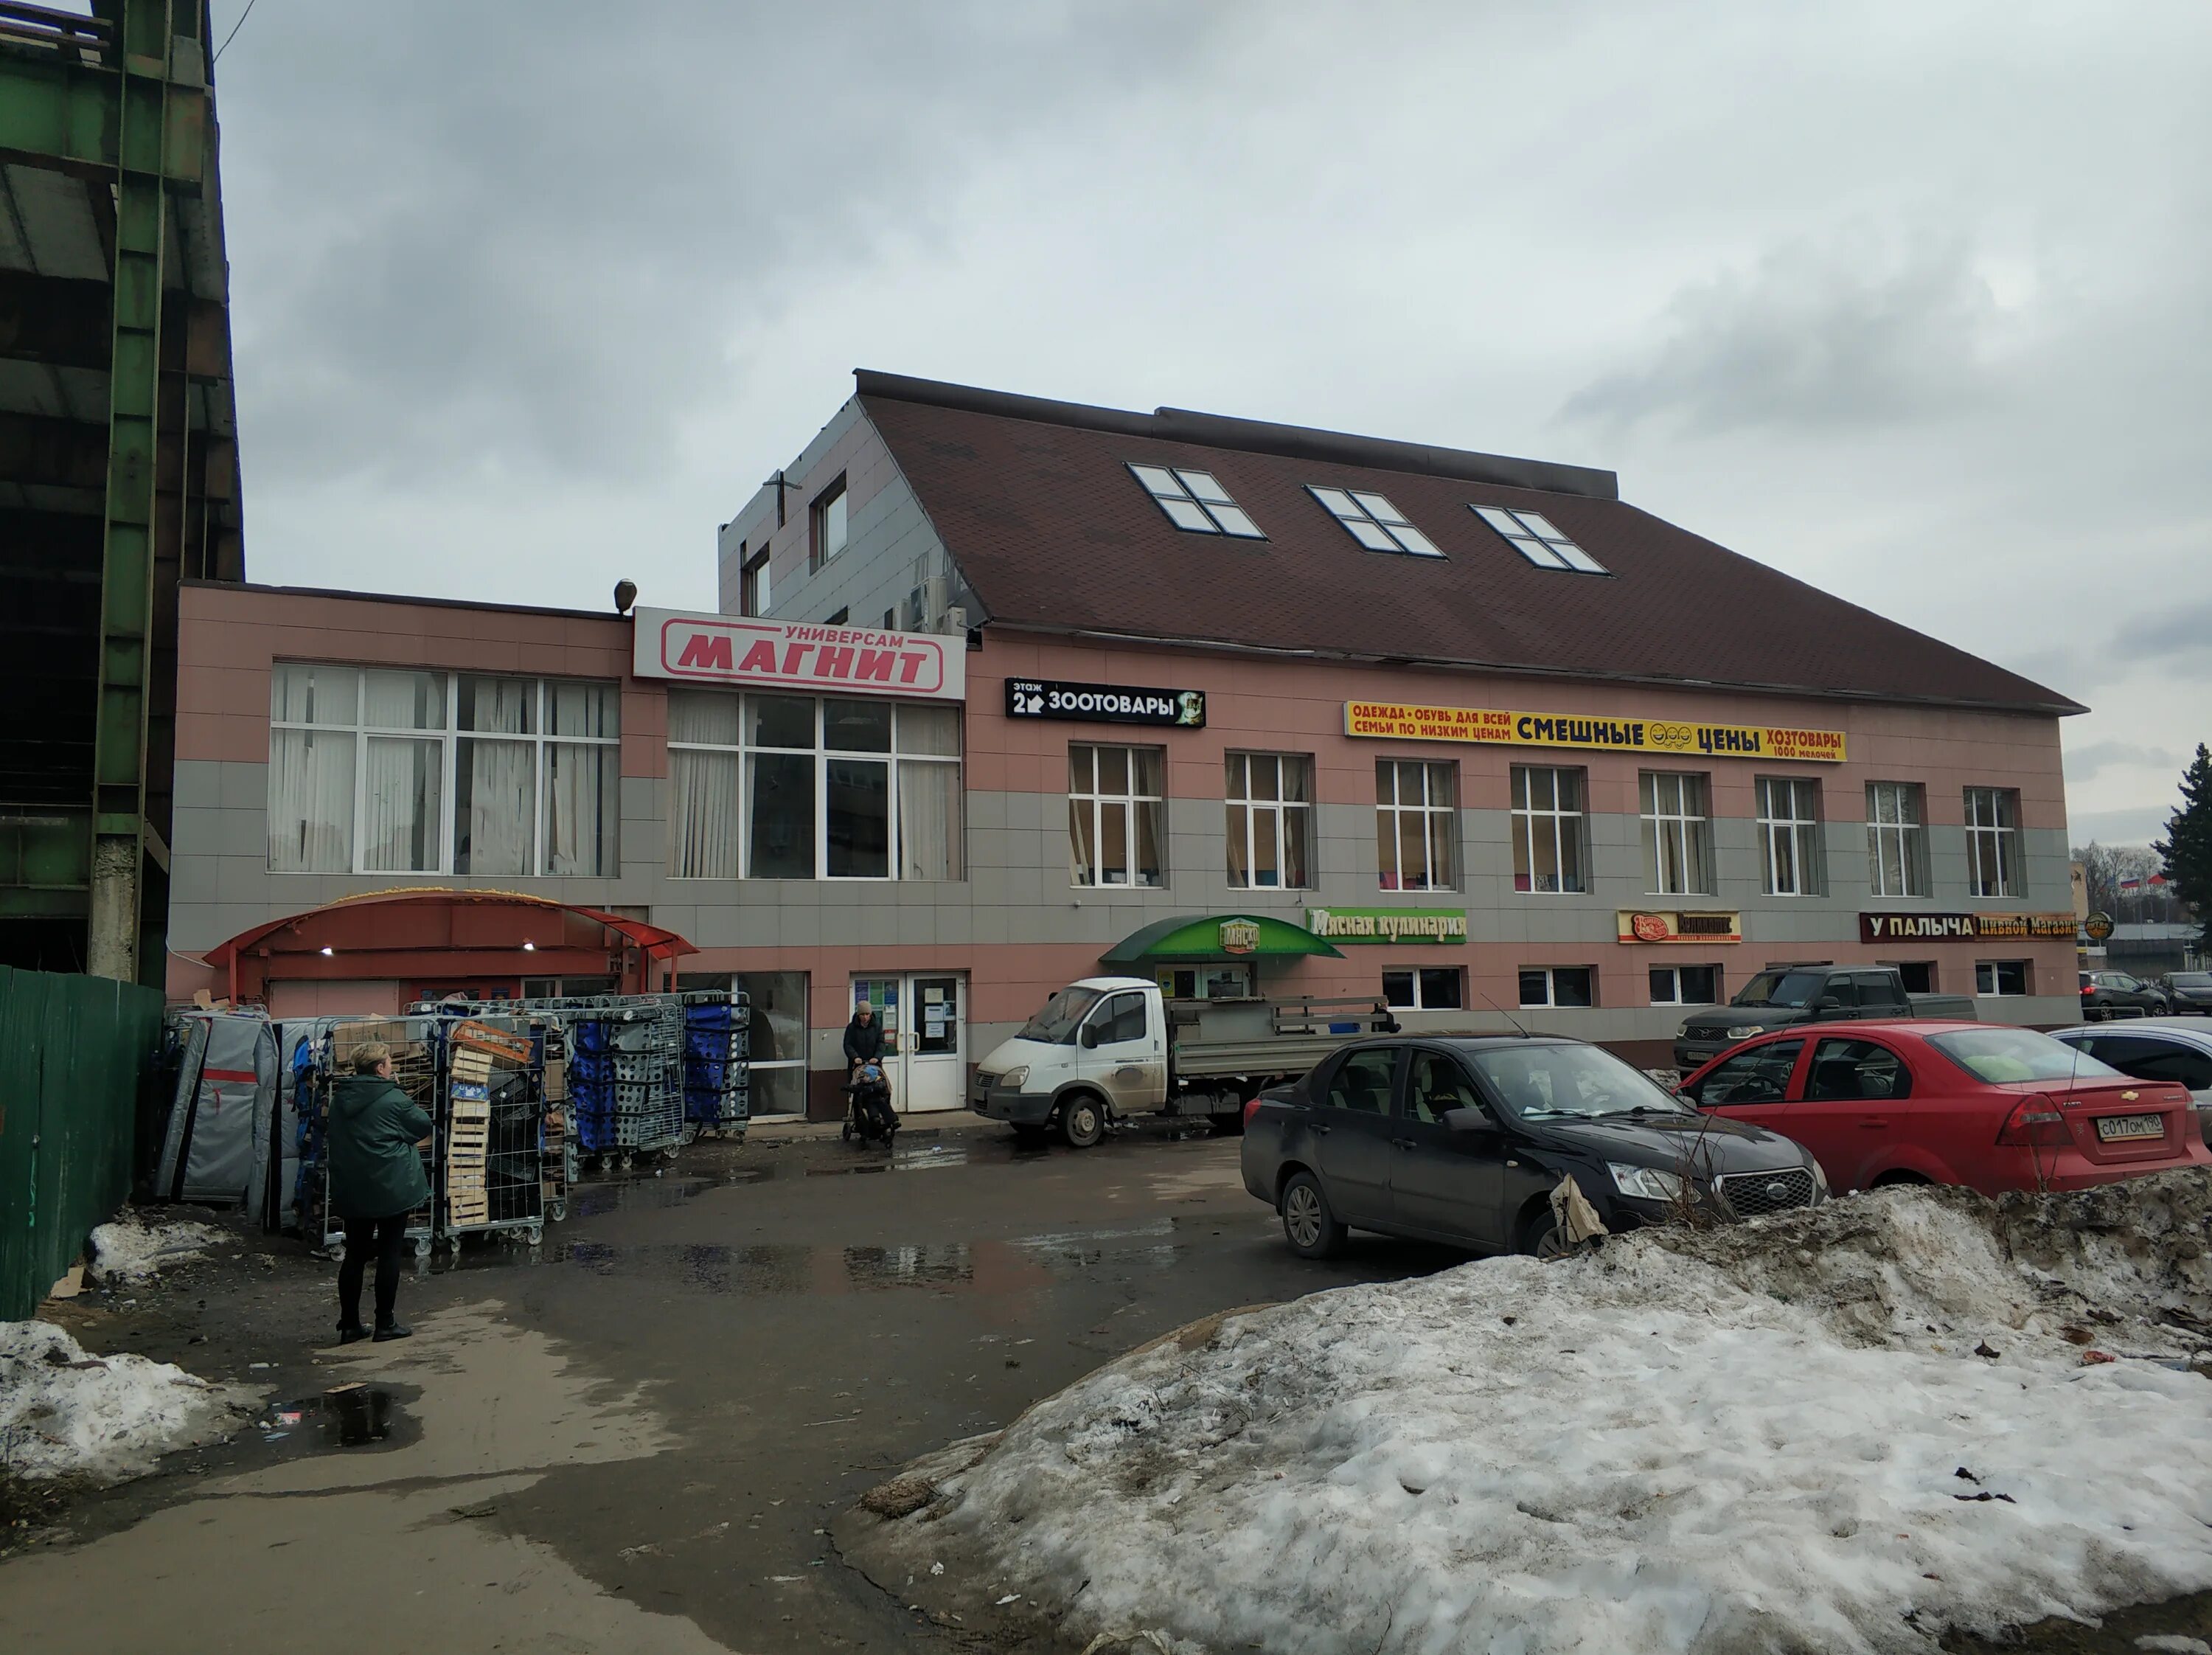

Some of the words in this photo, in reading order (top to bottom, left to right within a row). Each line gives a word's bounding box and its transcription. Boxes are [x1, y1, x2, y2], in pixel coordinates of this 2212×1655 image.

[785, 625, 905, 648] УНИВЕРСАМ
[678, 634, 927, 683] МАГНИТ
[1013, 683, 1042, 692] этаж
[1013, 693, 1026, 713] 2
[1048, 691, 1174, 715] ЗООТОВАРЫ
[1353, 705, 1405, 720] ОДЕЖДА
[1415, 709, 1452, 722] ОБУВЬ
[1456, 712, 1478, 724] ДЛЯ
[1484, 711, 1511, 726] ВСЕЙ
[1354, 721, 1394, 734] СЕМЬИ
[1399, 722, 1416, 735] ПО
[1421, 724, 1468, 738] НИЗКИМ
[1472, 726, 1511, 740] ЦЕНАМ
[1517, 717, 1644, 746] СМЕШНЫЕ
[1697, 728, 1761, 754] ЦЕНЫ
[1767, 729, 1842, 749] ХОЗТОВАРЫ
[1774, 746, 1795, 757] 1000
[1799, 749, 1836, 760] мелочей
[1310, 909, 1375, 936] Мясная
[1377, 916, 1467, 943] кулинария
[1870, 917, 1883, 936] У
[1889, 917, 1974, 936] ПАЛЫЧА
[1980, 915, 2027, 936] Пивной
[2031, 917, 2078, 935] Магазин
